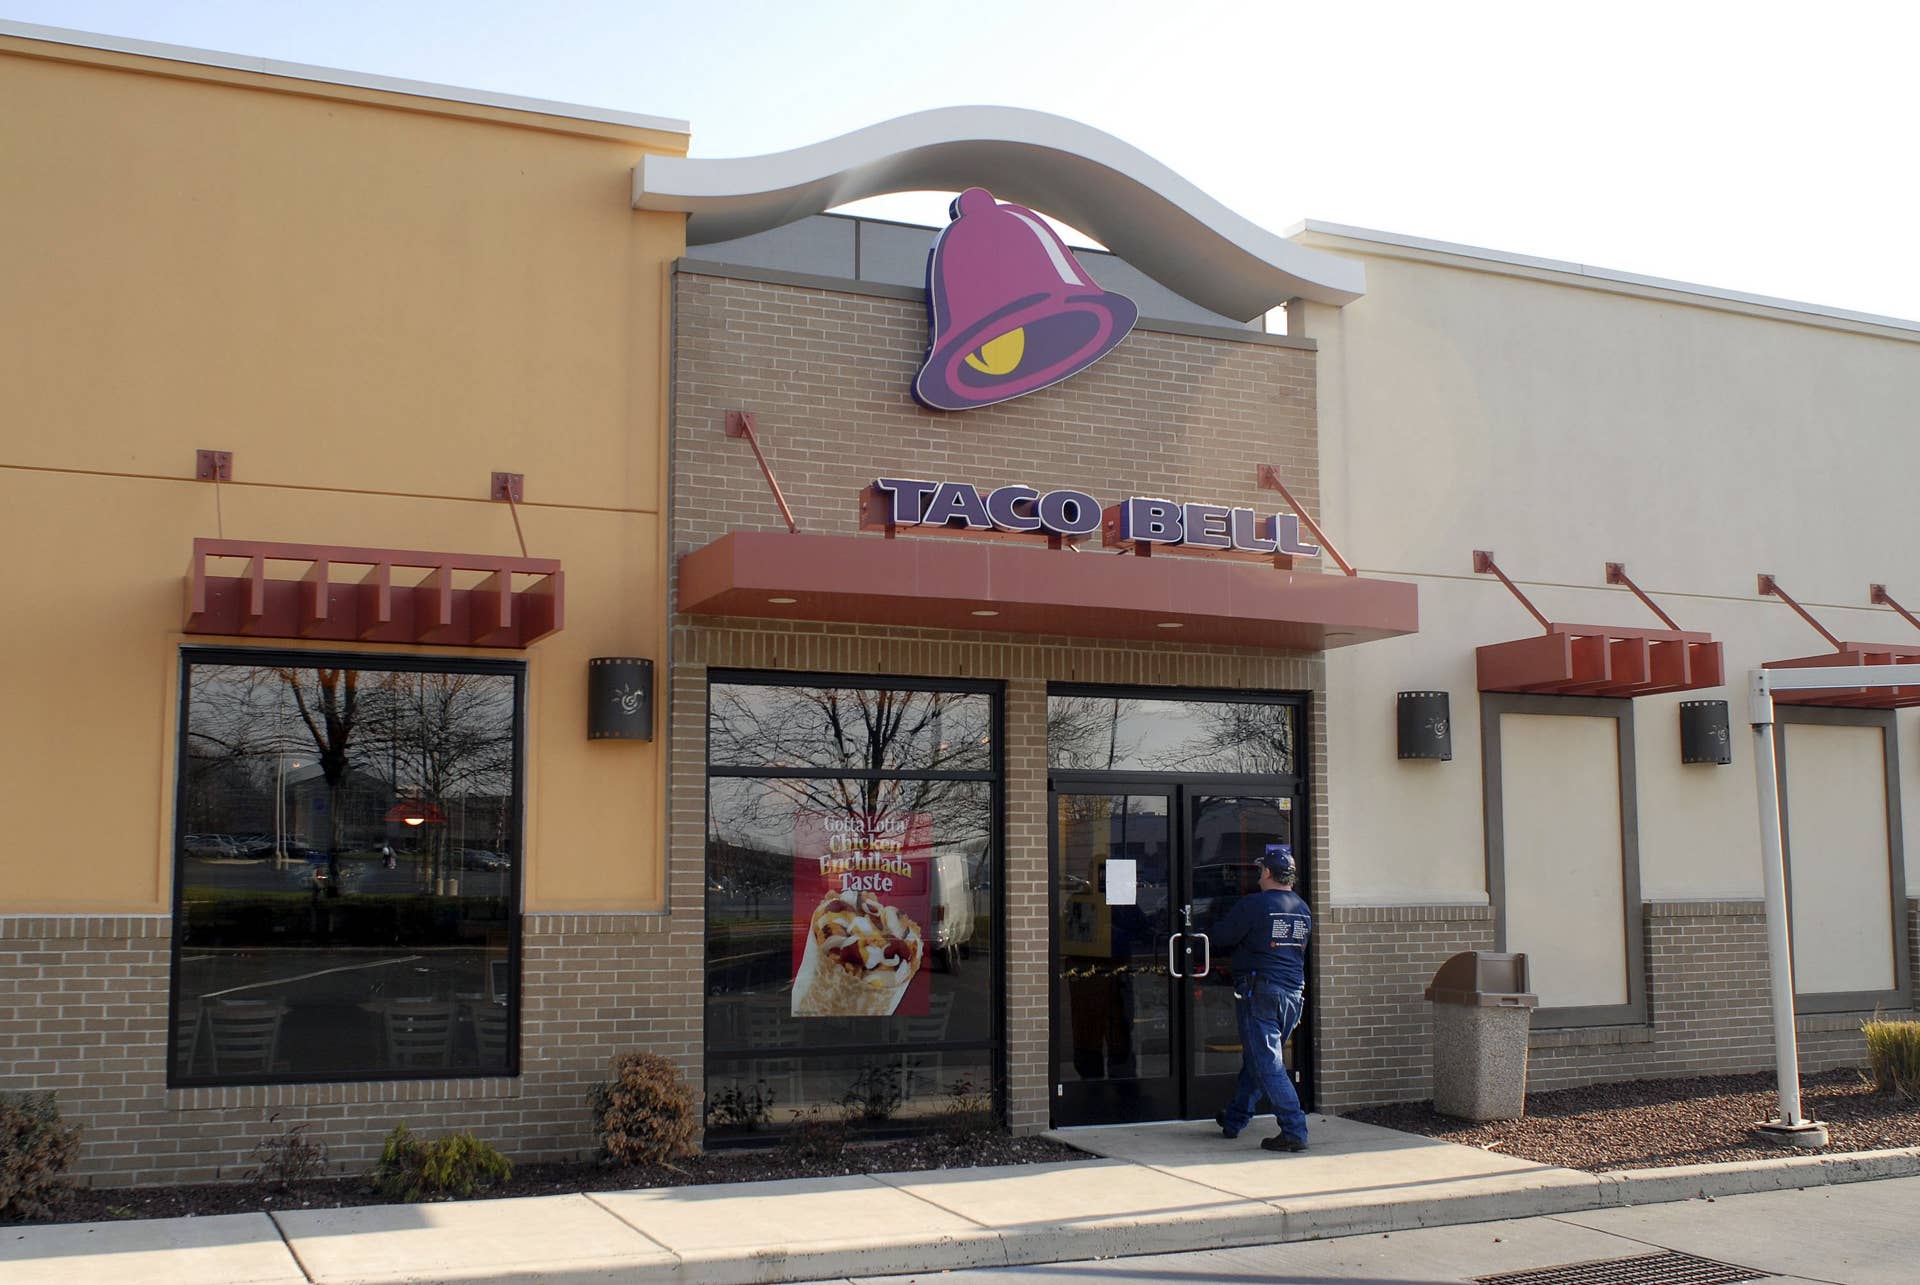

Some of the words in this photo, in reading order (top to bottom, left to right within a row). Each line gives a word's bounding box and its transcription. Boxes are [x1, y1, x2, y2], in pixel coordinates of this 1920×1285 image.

[875, 477, 1103, 534] TACO
[1124, 496, 1321, 557] BELL
[823, 815, 865, 834] Gotta
[829, 833, 902, 853] Chicken
[819, 851, 912, 878] Enchilada
[839, 873, 893, 892] Taste
